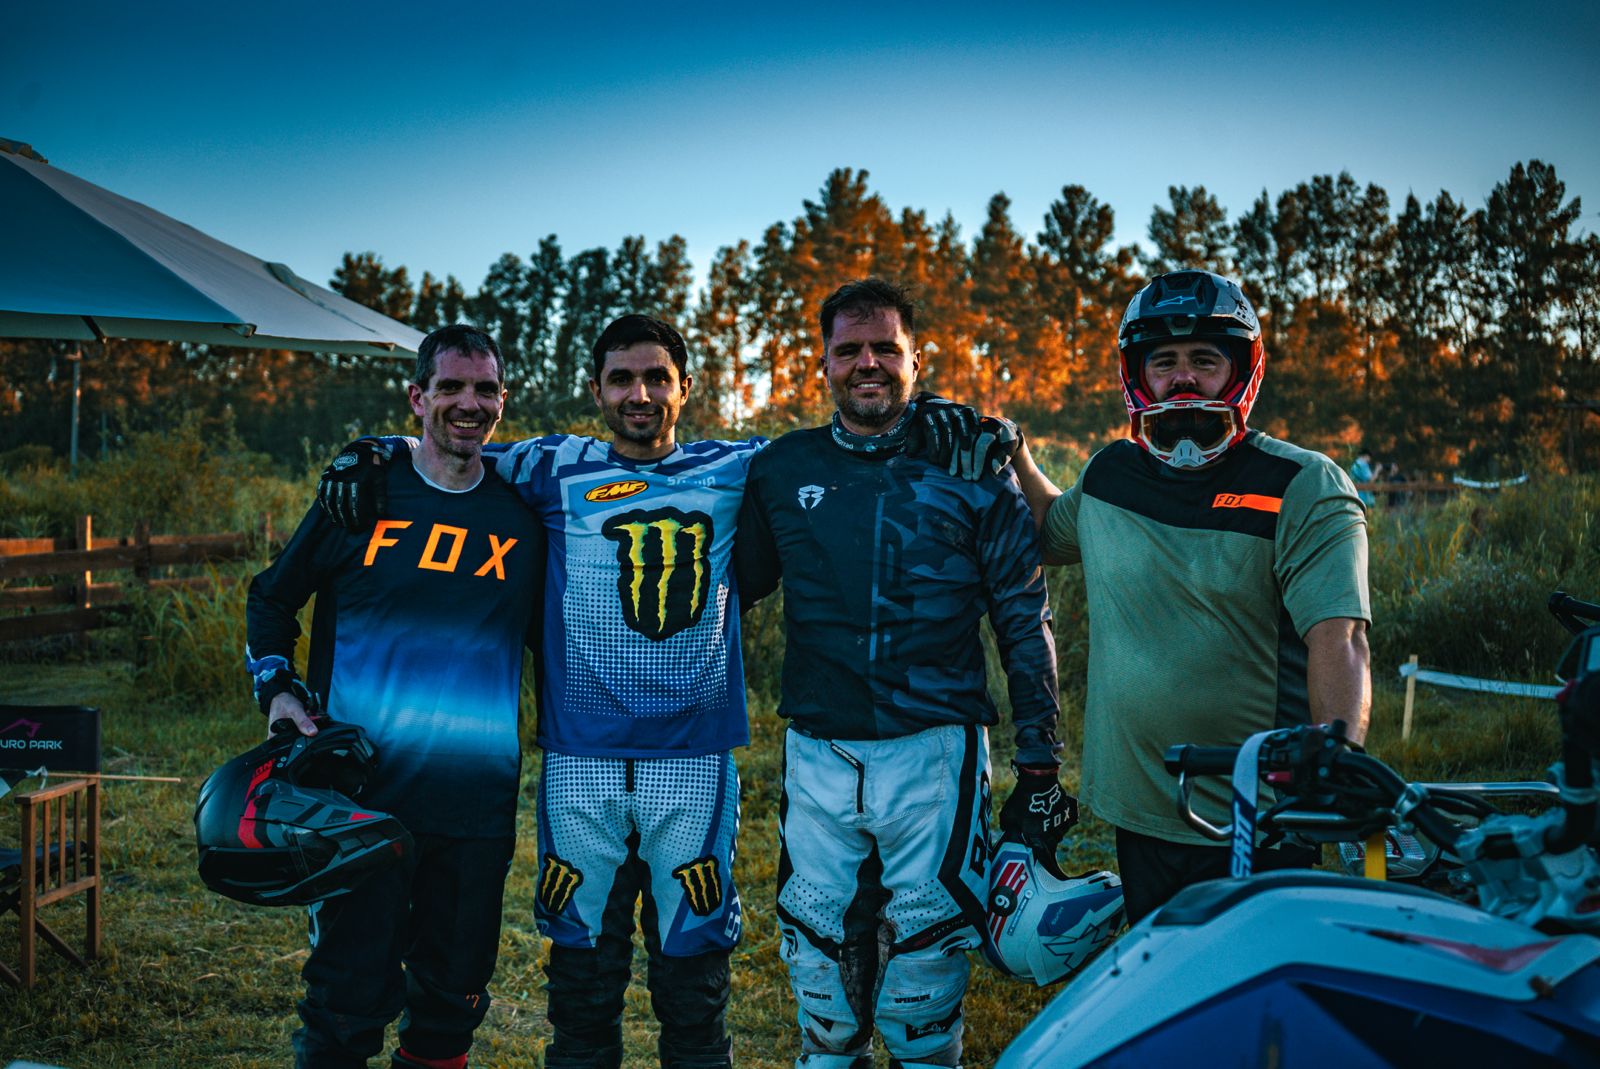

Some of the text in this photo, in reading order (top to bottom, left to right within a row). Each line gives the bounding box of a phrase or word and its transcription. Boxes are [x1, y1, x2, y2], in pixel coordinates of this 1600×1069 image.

[588, 481, 648, 500] FMF
[1216, 494, 1245, 506] FOX
[363, 519, 519, 581] FOX
[29, 739, 63, 750] PARK
[1043, 807, 1071, 832] FOX
